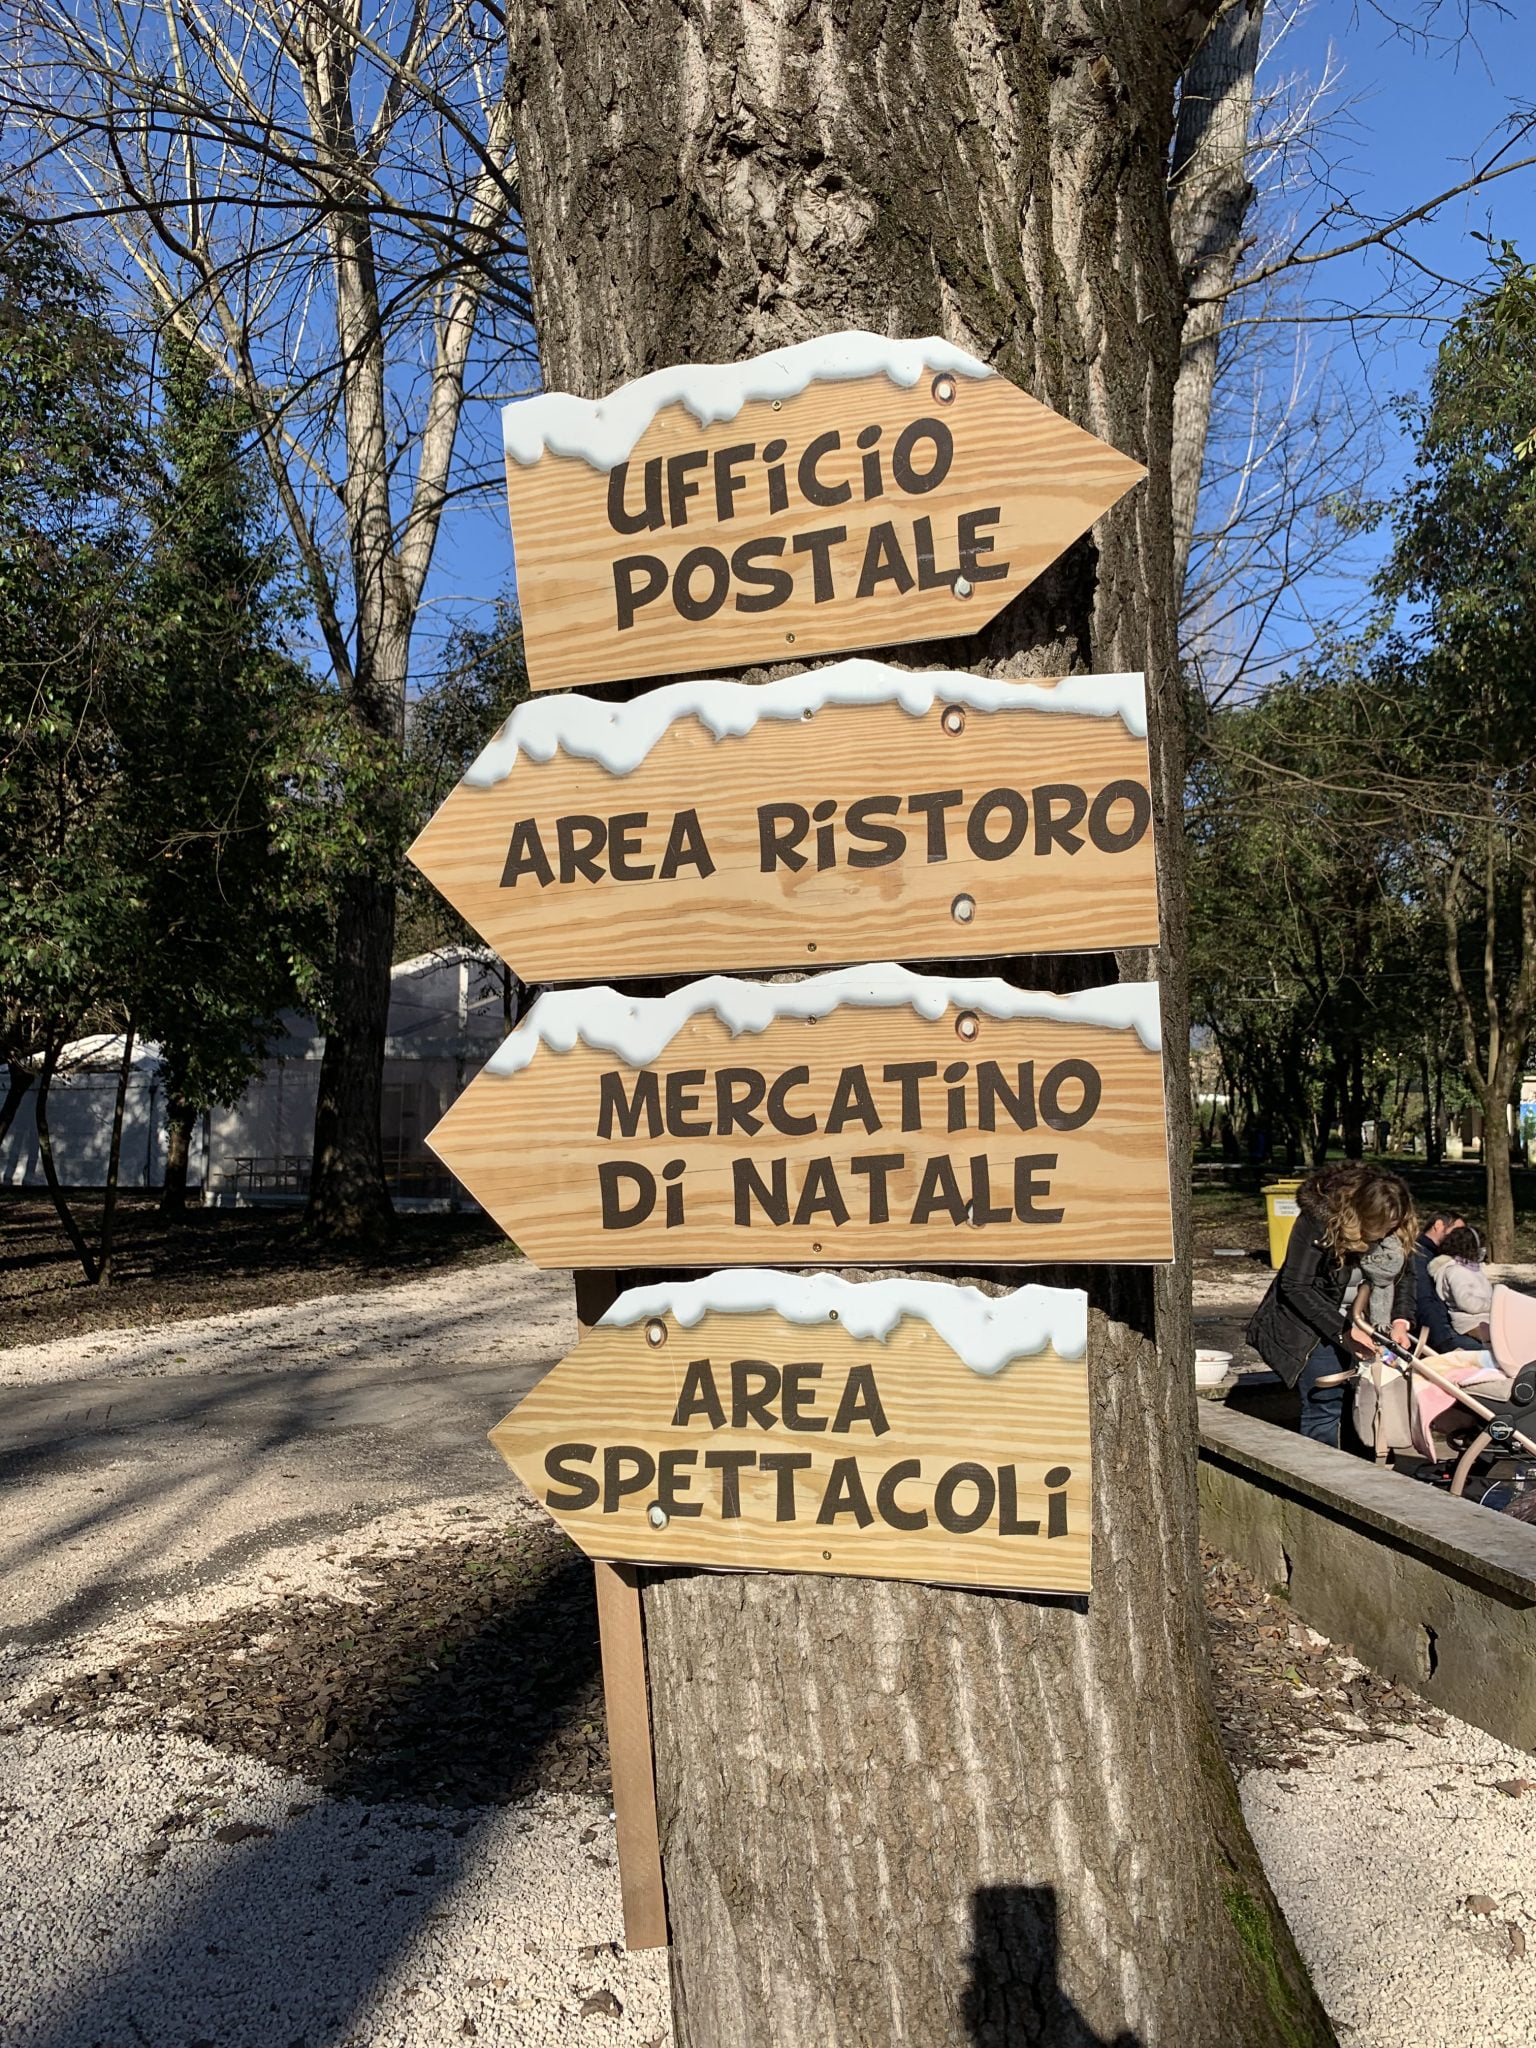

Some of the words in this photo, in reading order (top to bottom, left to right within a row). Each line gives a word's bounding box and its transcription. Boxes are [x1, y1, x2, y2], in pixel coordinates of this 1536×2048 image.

[612, 506, 1010, 631] POSTALE
[499, 808, 716, 888] AREA
[732, 1153, 1065, 1227] NATALE
[671, 1358, 891, 1437] AREA
